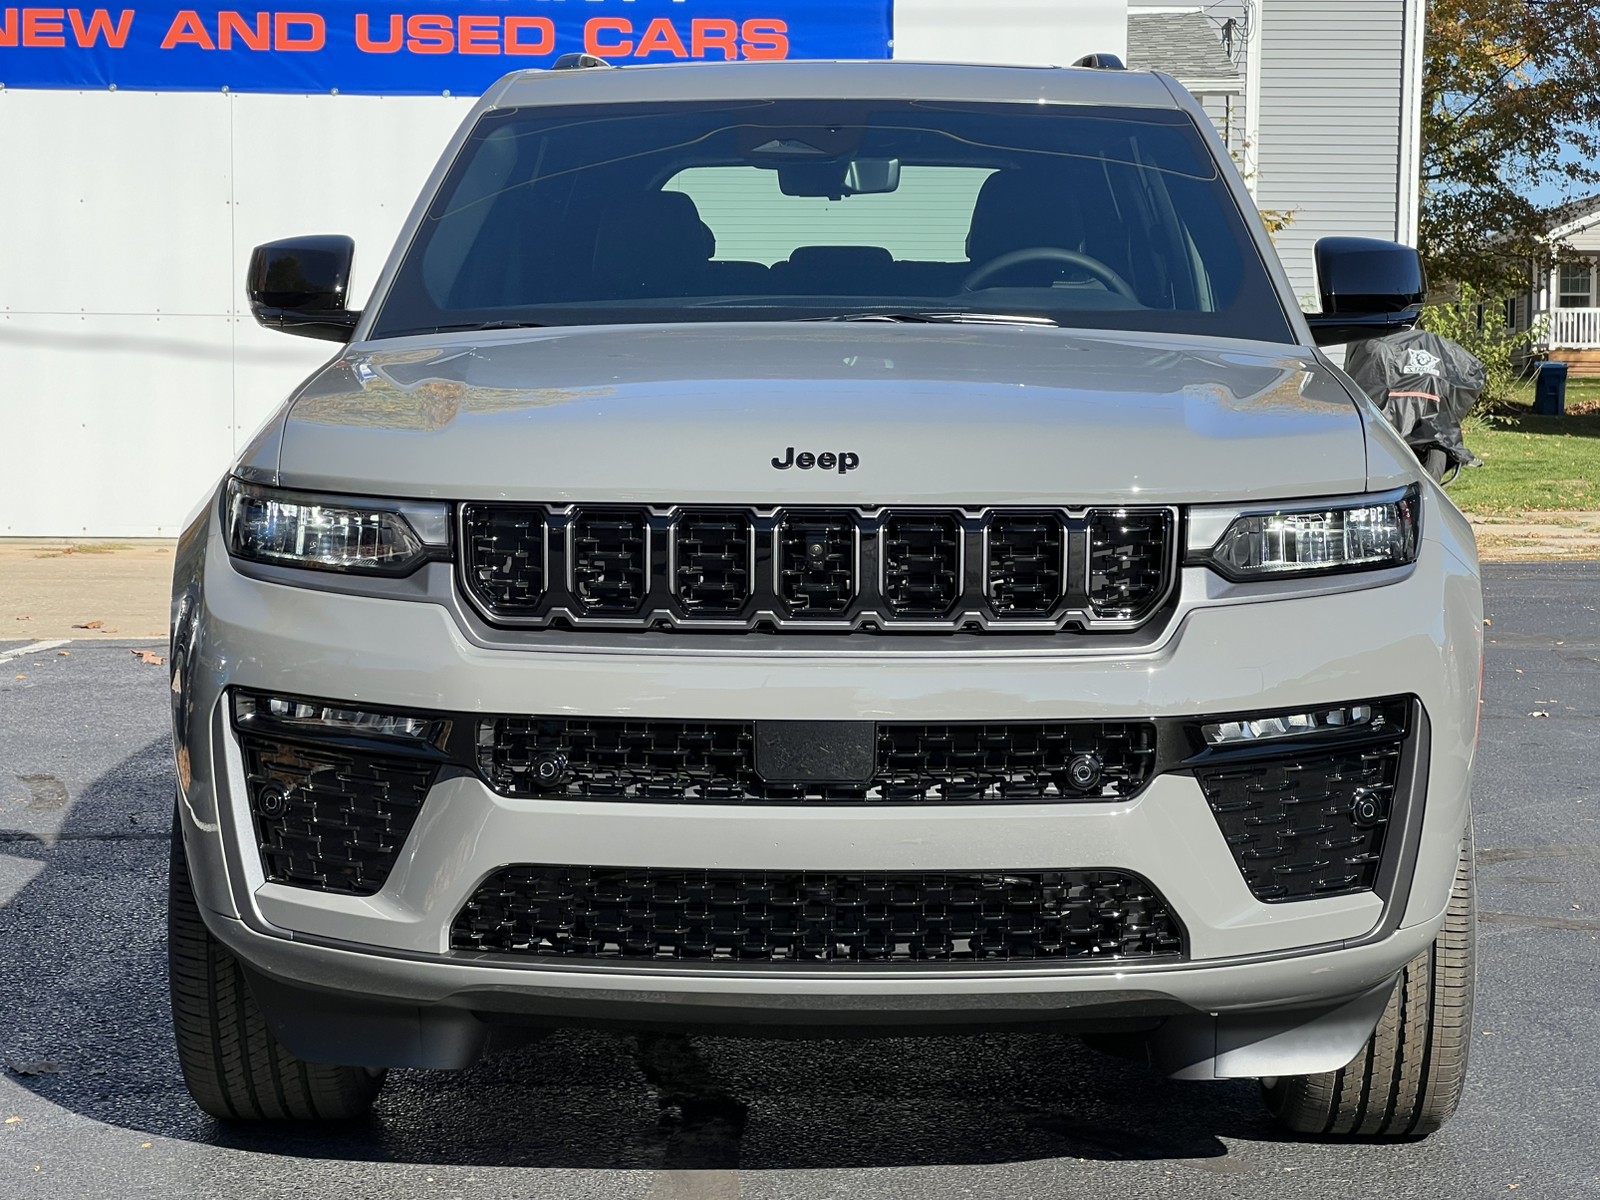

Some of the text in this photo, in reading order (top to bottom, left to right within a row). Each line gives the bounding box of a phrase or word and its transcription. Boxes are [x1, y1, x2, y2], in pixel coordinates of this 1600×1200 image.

[161, 11, 325, 51] AND
[356, 14, 555, 55] USED
[584, 17, 789, 60] CARS
[770, 446, 860, 475] Jeep
